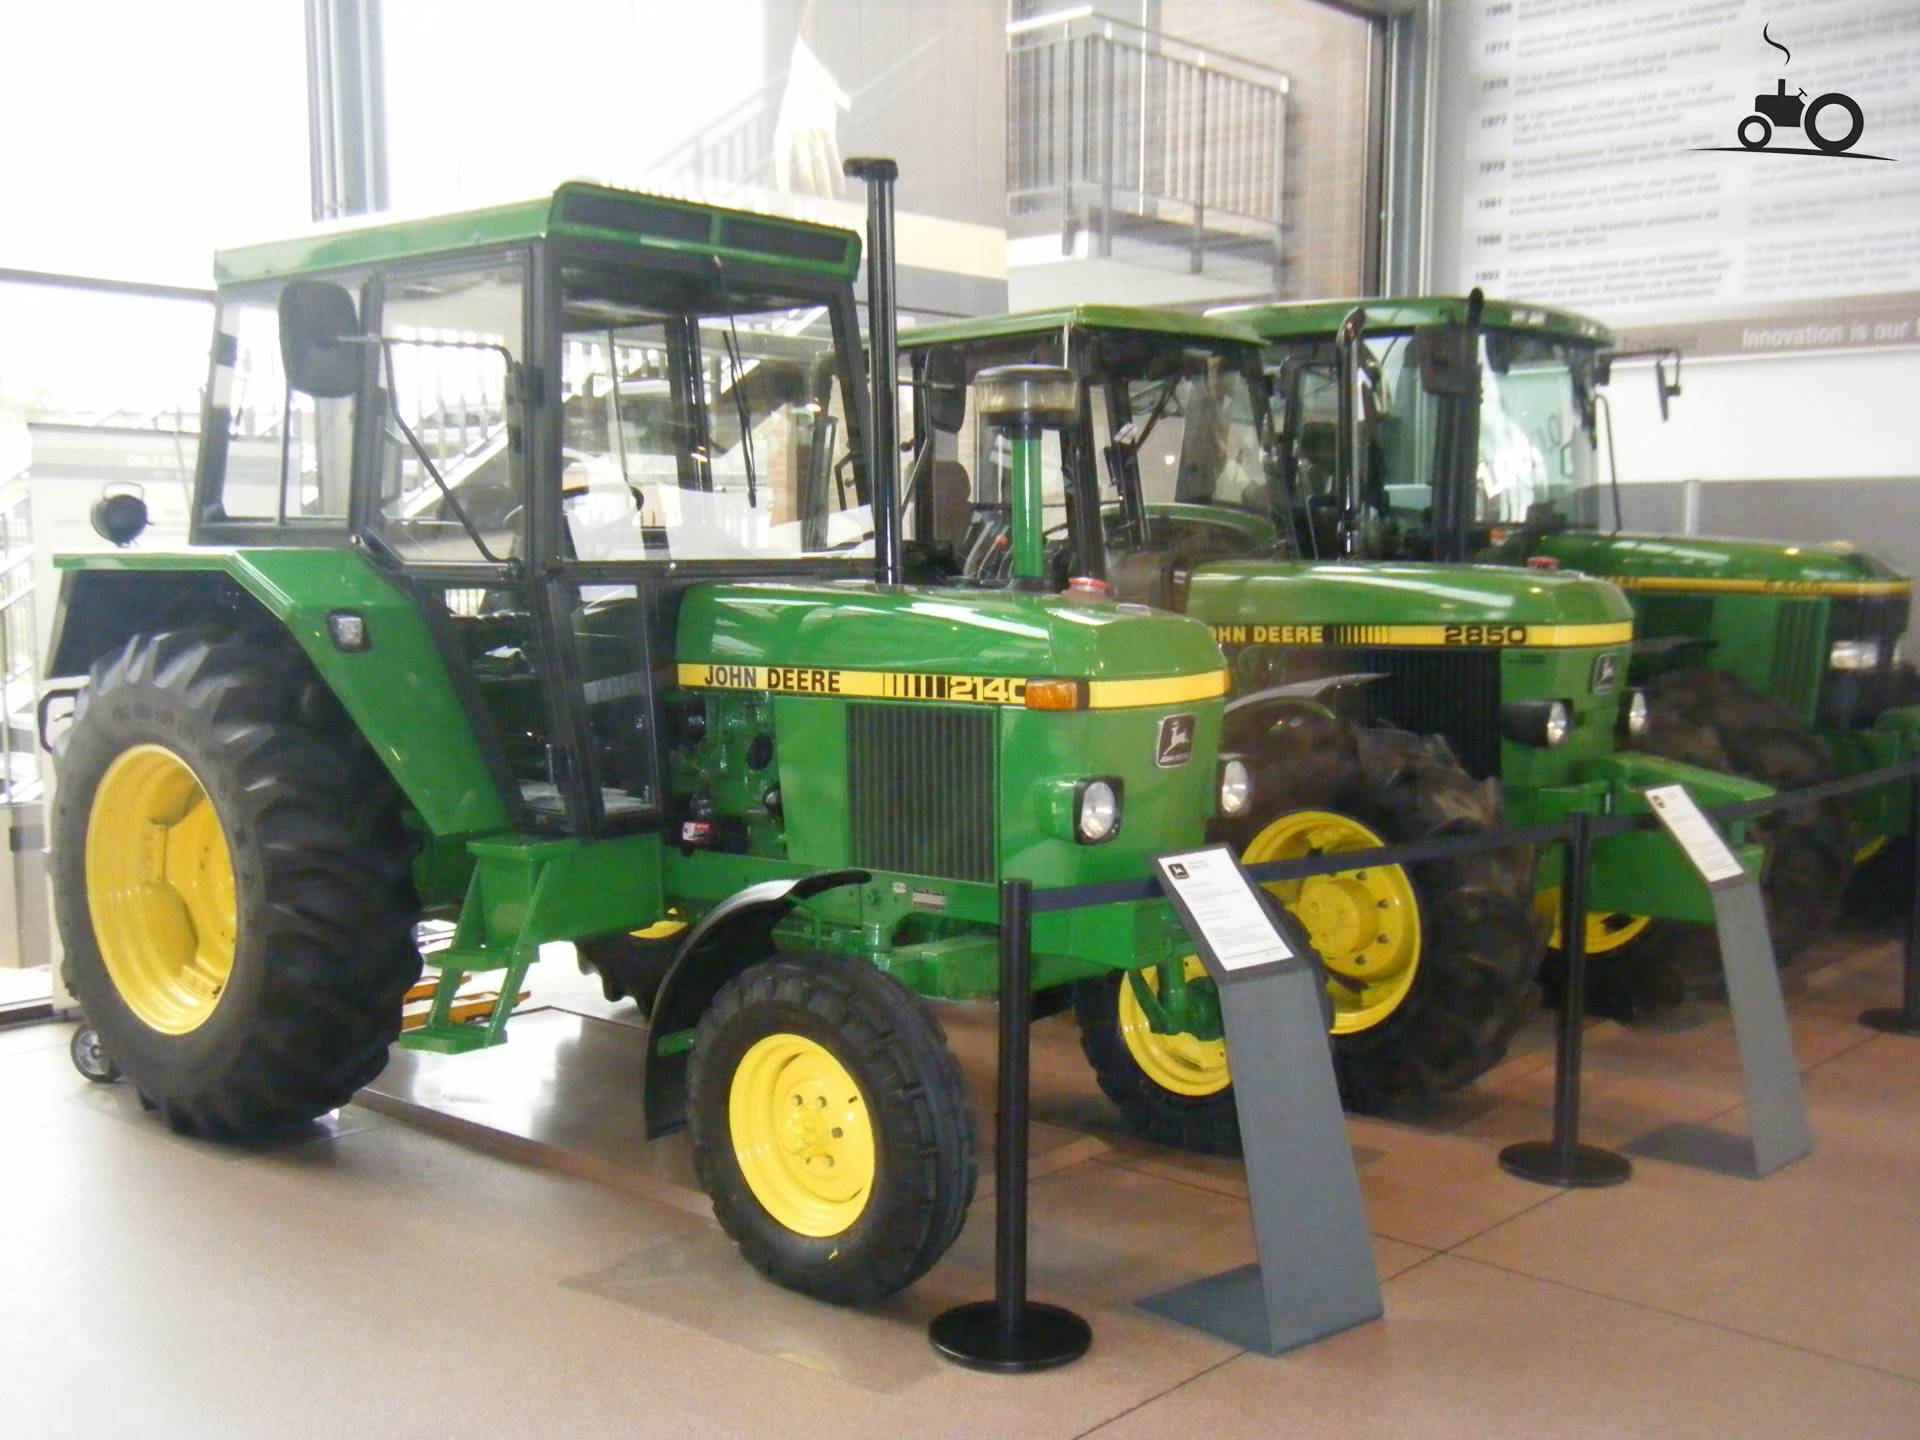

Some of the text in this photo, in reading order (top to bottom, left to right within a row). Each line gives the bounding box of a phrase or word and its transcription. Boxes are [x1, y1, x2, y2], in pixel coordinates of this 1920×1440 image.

[1742, 322, 1842, 349] Innovation
[1851, 319, 1868, 342] is
[1874, 319, 1908, 341] our
[1253, 625, 1324, 644] DEERE
[1445, 625, 1528, 645] 2850
[704, 664, 841, 693] JOHN DEERE
